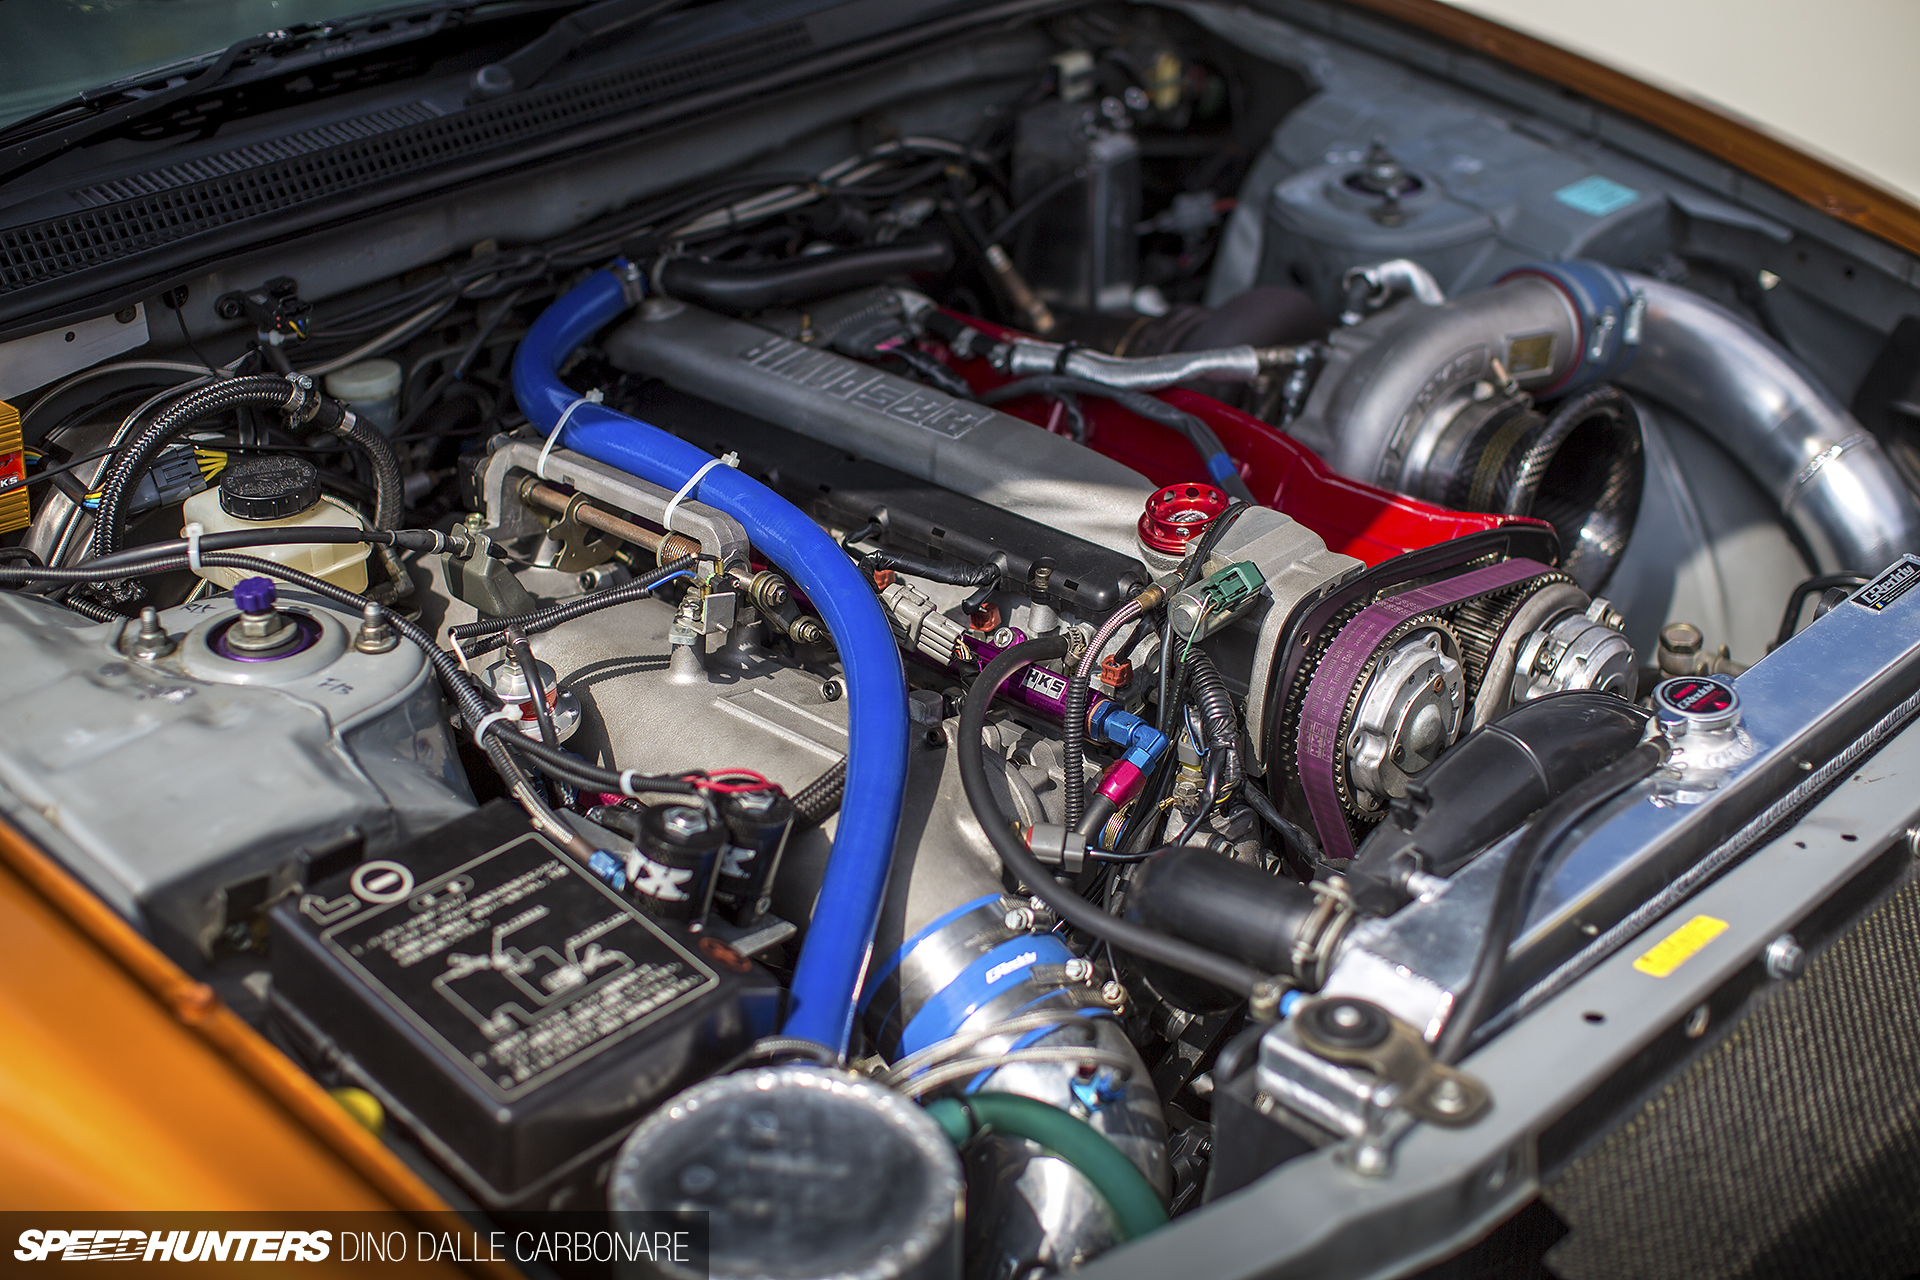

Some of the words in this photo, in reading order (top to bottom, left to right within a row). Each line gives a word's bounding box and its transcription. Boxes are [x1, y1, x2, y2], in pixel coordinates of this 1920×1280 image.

[1860, 564, 1915, 604] GReddy
[1343, 649, 1355, 663] Belt
[1023, 667, 1067, 697] HKS
[1331, 662, 1348, 686] Timing
[1301, 717, 1313, 753] HKS
[1309, 700, 1319, 715] Fine
[1314, 682, 1325, 699] Tune
[1321, 658, 1337, 681] Timing
[1332, 645, 1344, 660] Belt
[1324, 686, 1337, 703] Tune
[1317, 704, 1330, 720] Fine
[1310, 721, 1325, 759] HKS
[1322, 726, 1335, 764] HKS
[1330, 709, 1342, 724] Fine
[1336, 691, 1349, 709] Tune
